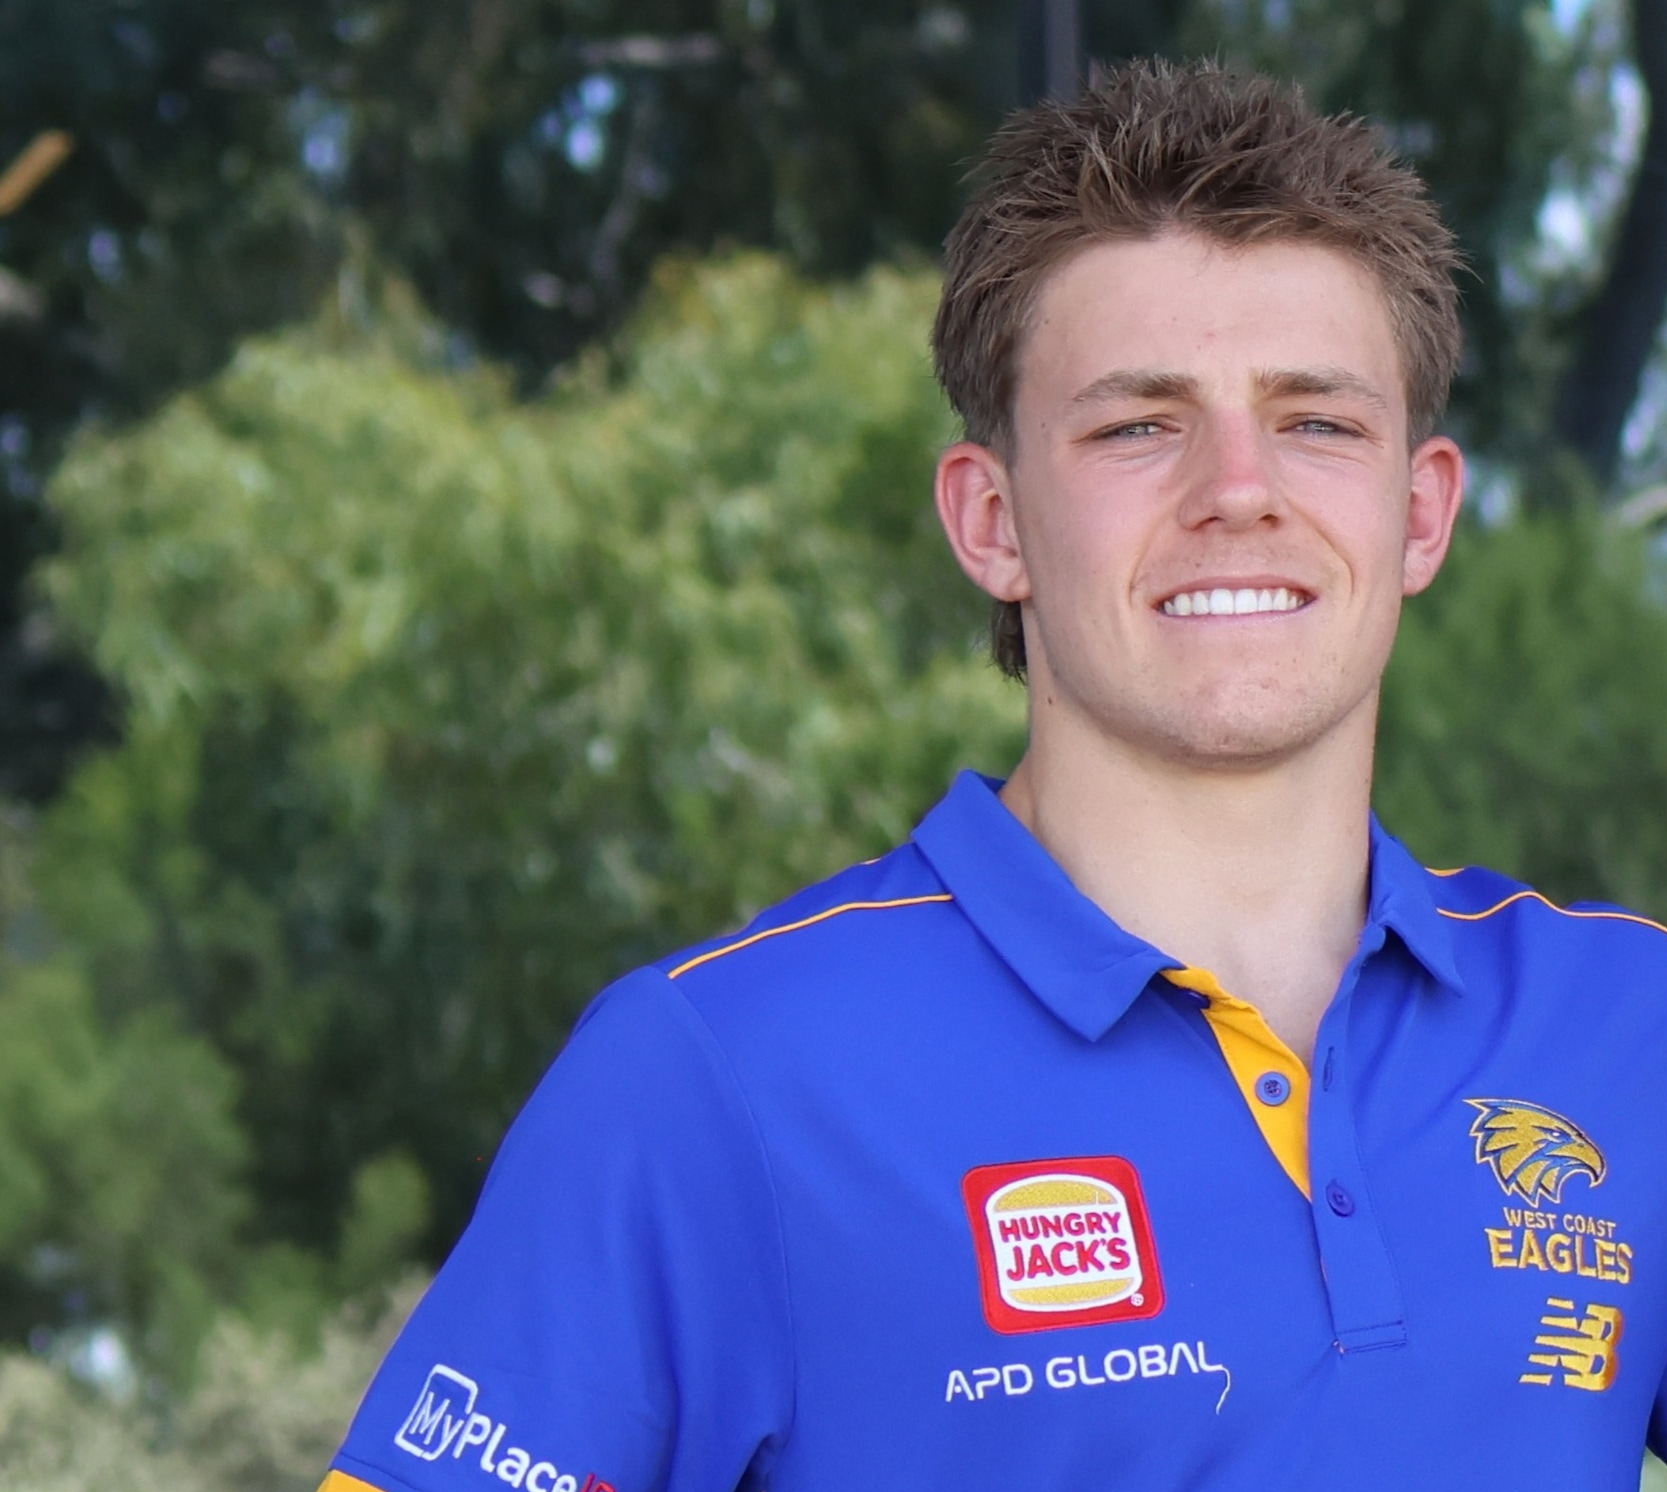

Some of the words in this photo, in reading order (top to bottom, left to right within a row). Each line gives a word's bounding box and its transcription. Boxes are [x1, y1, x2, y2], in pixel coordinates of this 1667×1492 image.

[998, 1212, 1121, 1243] HUNGRY
[1503, 1207, 1557, 1231] WEST
[1563, 1213, 1616, 1239] COAST
[1006, 1237, 1132, 1281] JACK'S
[1485, 1228, 1633, 1284] EAGLES
[945, 1363, 1033, 1402] APD
[1046, 1341, 1222, 1389] GLOBAL
